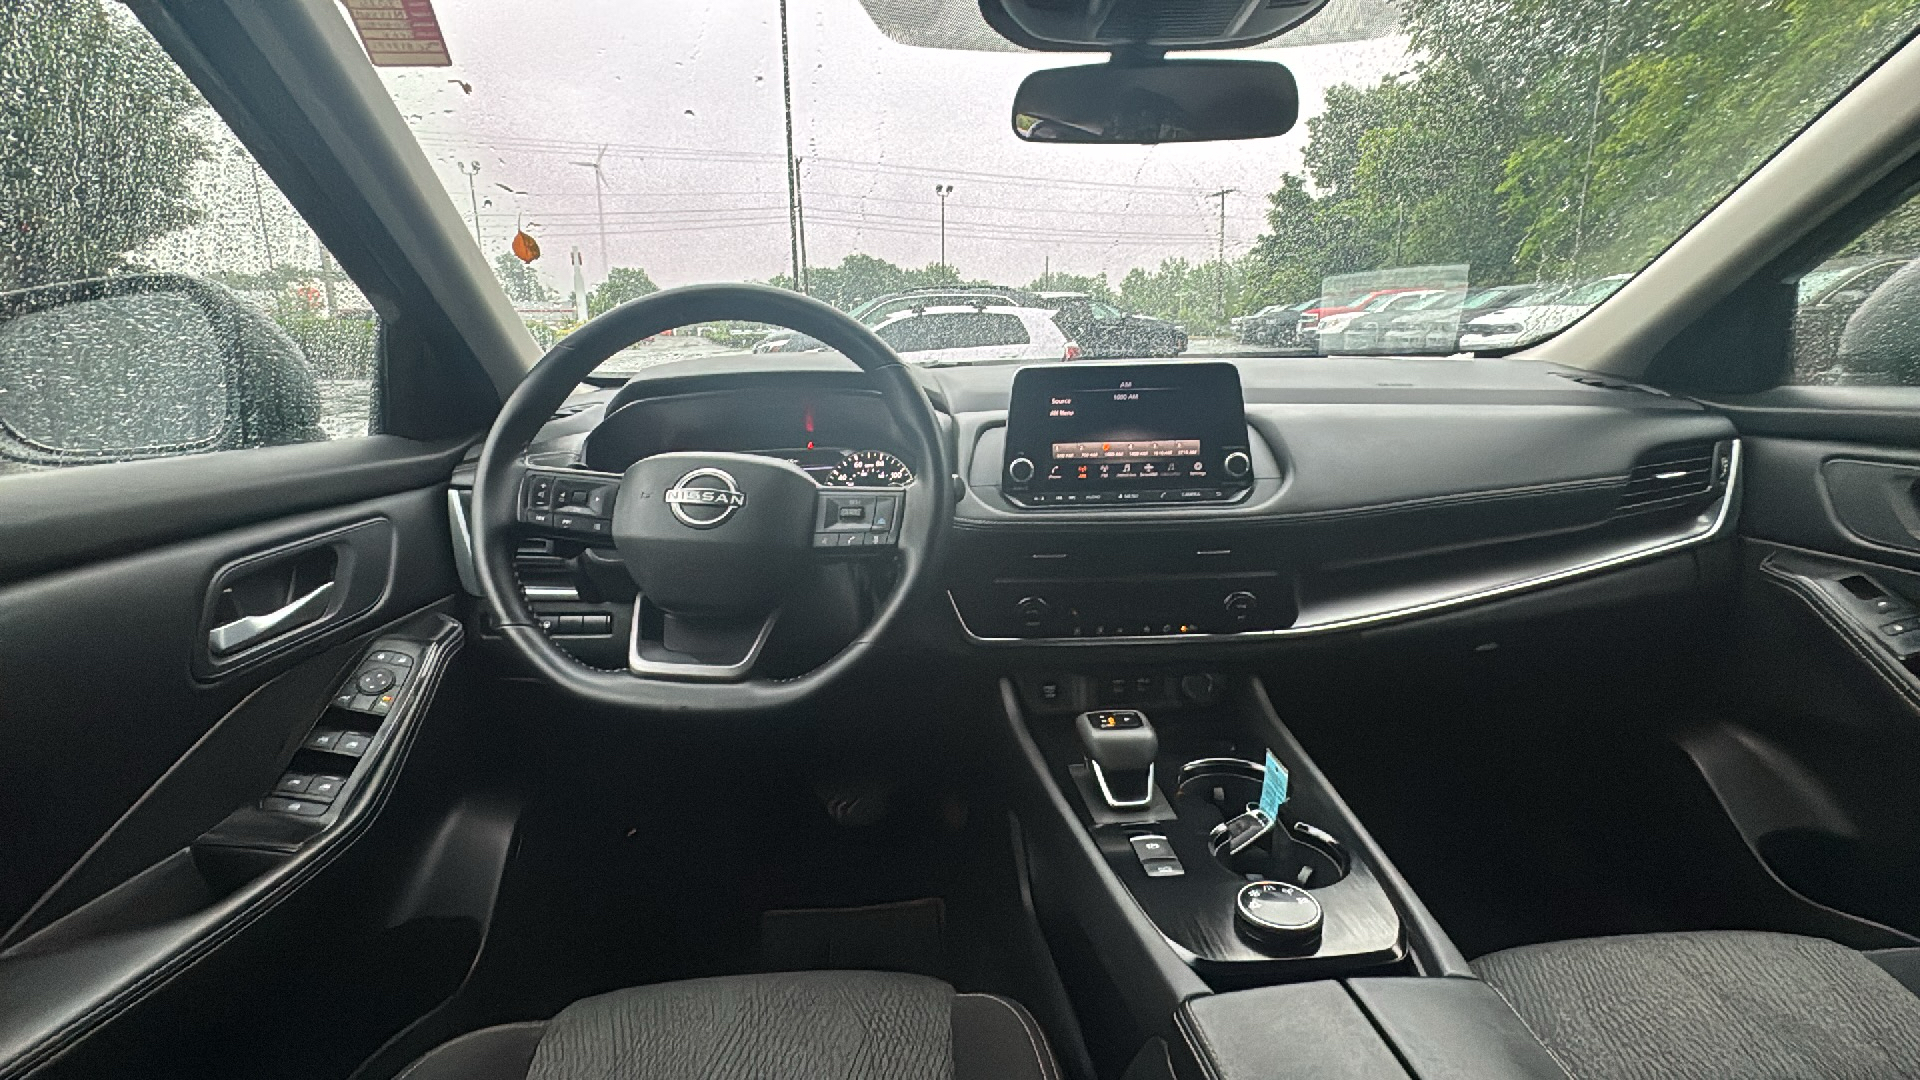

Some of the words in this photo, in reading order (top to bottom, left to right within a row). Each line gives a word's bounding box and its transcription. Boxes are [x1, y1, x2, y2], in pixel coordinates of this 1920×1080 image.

[1051, 397, 1072, 405] Source
[853, 461, 863, 469] 60
[891, 471, 902, 479] 100
[667, 491, 745, 506] NISSAN
